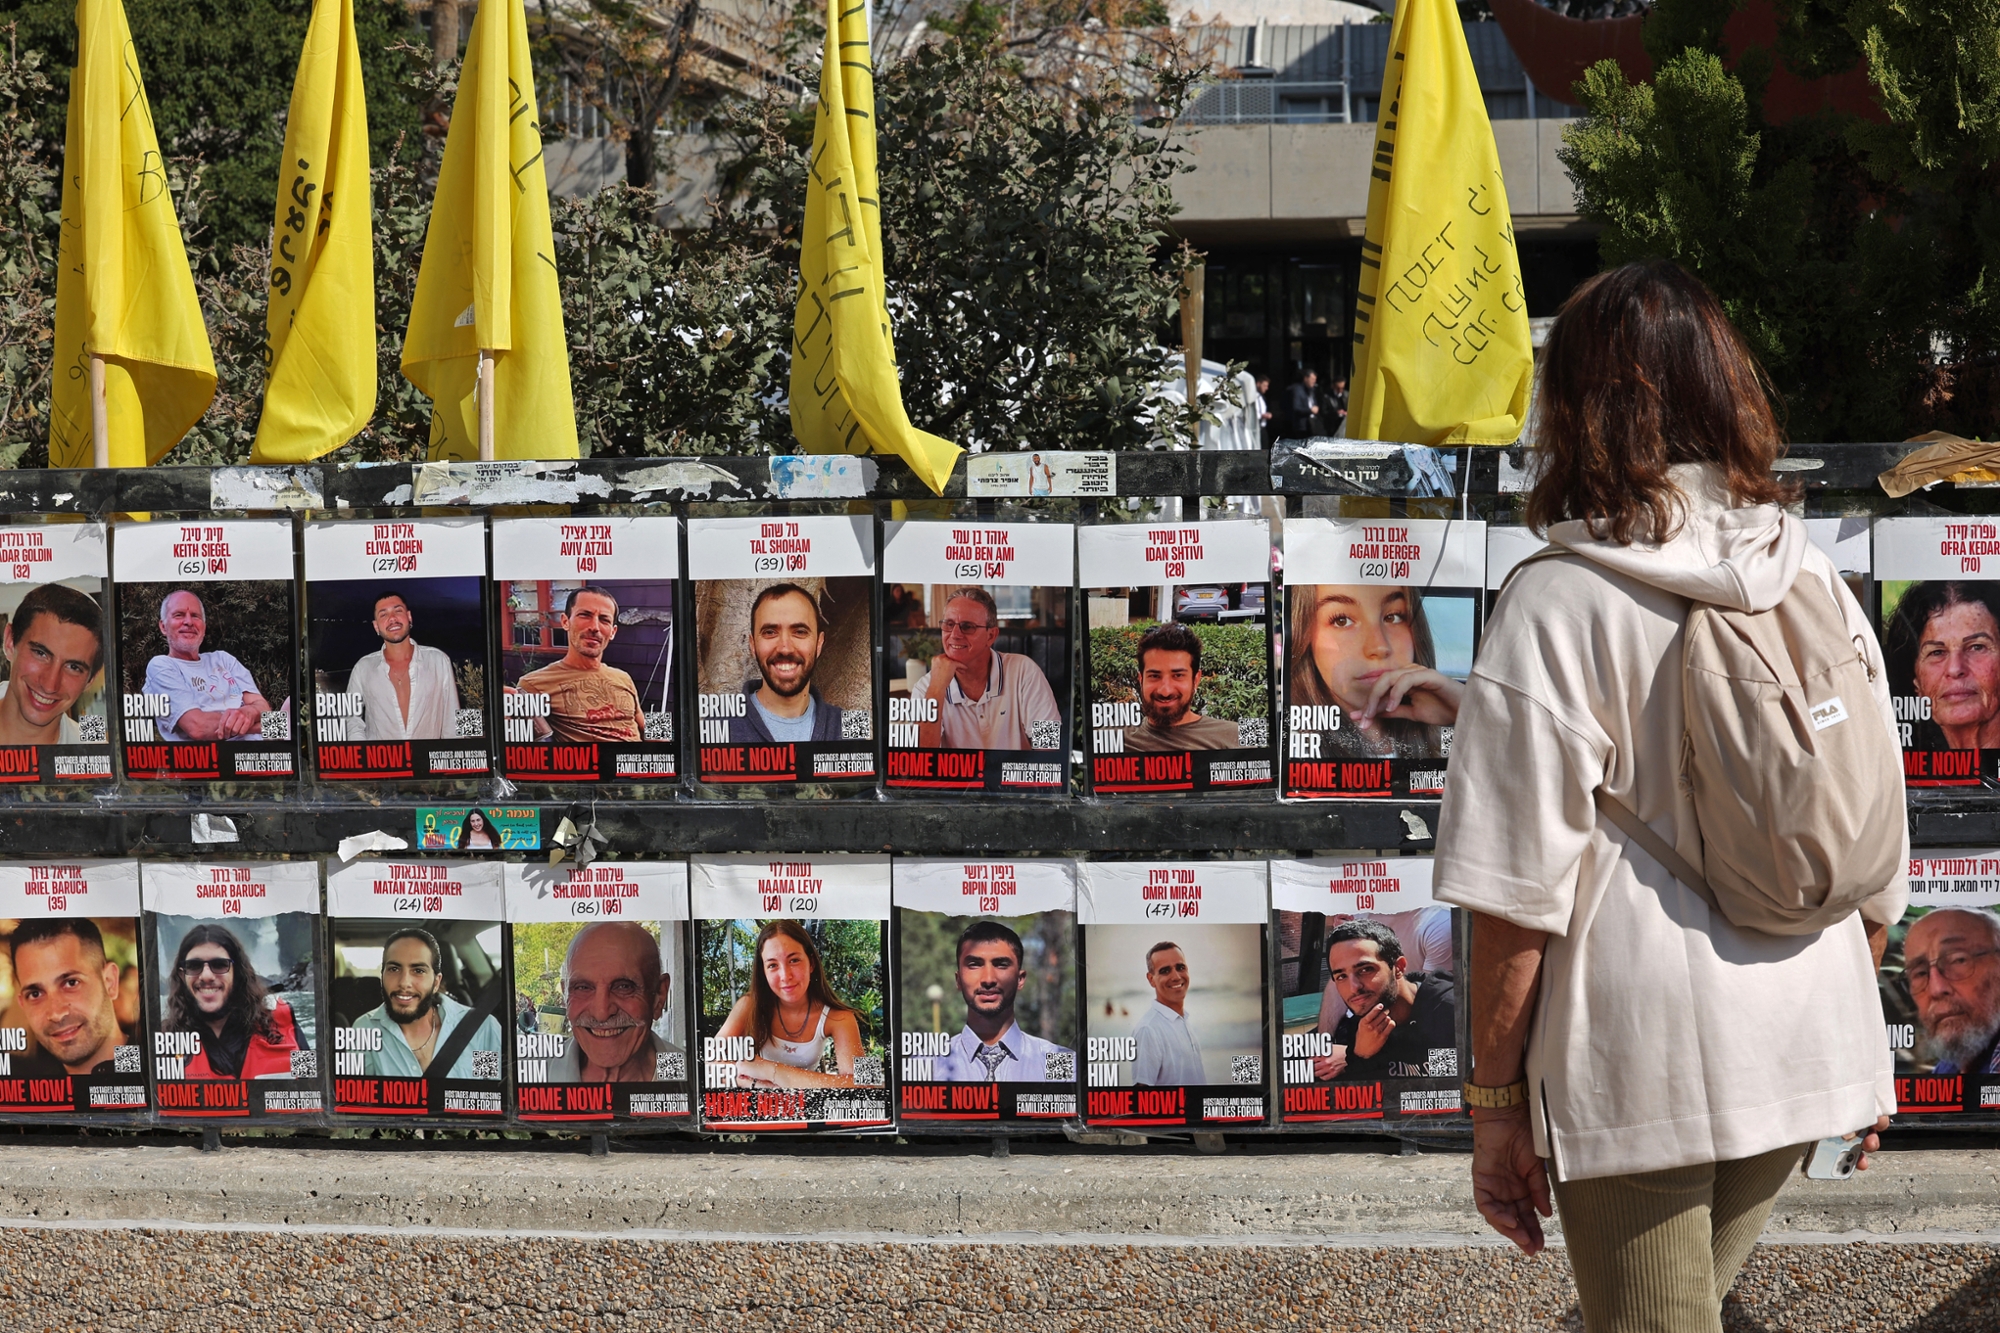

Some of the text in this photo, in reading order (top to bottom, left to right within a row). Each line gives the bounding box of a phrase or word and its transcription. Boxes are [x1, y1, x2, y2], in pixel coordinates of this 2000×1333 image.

[1357, 470, 1380, 483] עדן
[181, 528, 201, 541] סיגל
[374, 524, 414, 540] אליה כהן
[561, 525, 611, 540] אביב אצילי
[762, 522, 798, 538] טל שהם
[953, 530, 1008, 545] אוהד בן עמי
[1180, 530, 1199, 545] עידן
[1362, 528, 1407, 543] אגם ברגר
[1972, 524, 1996, 539] עפרה
[27, 532, 42, 545] הדר
[22, 548, 52, 562] GOLDIN
[174, 543, 232, 558] KEITH SIEGEL
[366, 540, 423, 555] ELIYA COHEN
[561, 542, 612, 555] AVIV ATZILI
[751, 539, 811, 556] TAL SHOHAM
[946, 546, 1014, 560] OHAD BEN AMI
[1146, 546, 1203, 561] IDAN SHTIVI
[1350, 544, 1420, 560] AGAM BERGER
[1941, 540, 2000, 556] OFRA KEDAR
[14, 564, 30, 578] (32)
[179, 561, 205, 574] (65)
[373, 559, 398, 572] (27)
[578, 558, 596, 572] (49)
[755, 558, 783, 572] (39)
[955, 564, 981, 578] (55)
[1165, 562, 1185, 578] (28)
[1360, 563, 1387, 578] (20)
[1962, 557, 1980, 572] (70)
[123, 693, 170, 717] BRING
[888, 697, 938, 723] BRING
[1811, 704, 1839, 721] FILA
[1289, 705, 1340, 731] BRING
[124, 718, 155, 742] HIM
[888, 723, 919, 748] HIM
[1289, 732, 1321, 759] HER
[127, 743, 219, 770] HOME NOW!
[235, 760, 293, 772] FAMILIES FORUM
[887, 751, 985, 778] HOME NOW!
[1001, 770, 1062, 783] FAMILIES FORUM
[1288, 760, 1392, 788] HOME NOW!
[489, 807, 535, 818] נעמה לוי
[31, 867, 48, 880] ברוך
[211, 868, 250, 882] סהר ברוך
[431, 867, 446, 880] מתן
[596, 868, 623, 882] שלמה
[770, 862, 811, 877] נעמה לוי
[991, 866, 1015, 880] ביפין
[1344, 863, 1386, 877] נמרוד כהן
[1148, 870, 1194, 886] עמרי מירן
[1330, 878, 1400, 893] NIMROD COHEN
[26, 881, 87, 895] URIEL BARUCH
[197, 884, 266, 898] SAHAR BARUCH
[374, 880, 461, 896] MATAN ZANGAUKER
[554, 884, 638, 898] SHLOMO MANTZUR
[758, 880, 822, 894] NAAMA LEVY
[962, 881, 1016, 895] BIPIN JOSHI
[1142, 886, 1202, 901] OMRI MIRAN
[48, 896, 66, 910] (35)
[222, 900, 240, 913] (24)
[394, 899, 420, 912] (24)
[572, 902, 599, 915] (86)
[790, 898, 817, 912] (20)
[980, 897, 998, 911] (23)
[1357, 895, 1374, 909] (19)
[1146, 904, 1175, 918] (47)
[516, 1033, 564, 1057] BRING
[1087, 1037, 1136, 1062] BRING
[517, 1059, 547, 1083] HIM
[1087, 1063, 1118, 1088] HIM
[518, 1084, 613, 1110] HOME NOW!
[1087, 1087, 1186, 1116] HOME NOW!
[630, 1101, 689, 1113] FAMILIES FORUM
